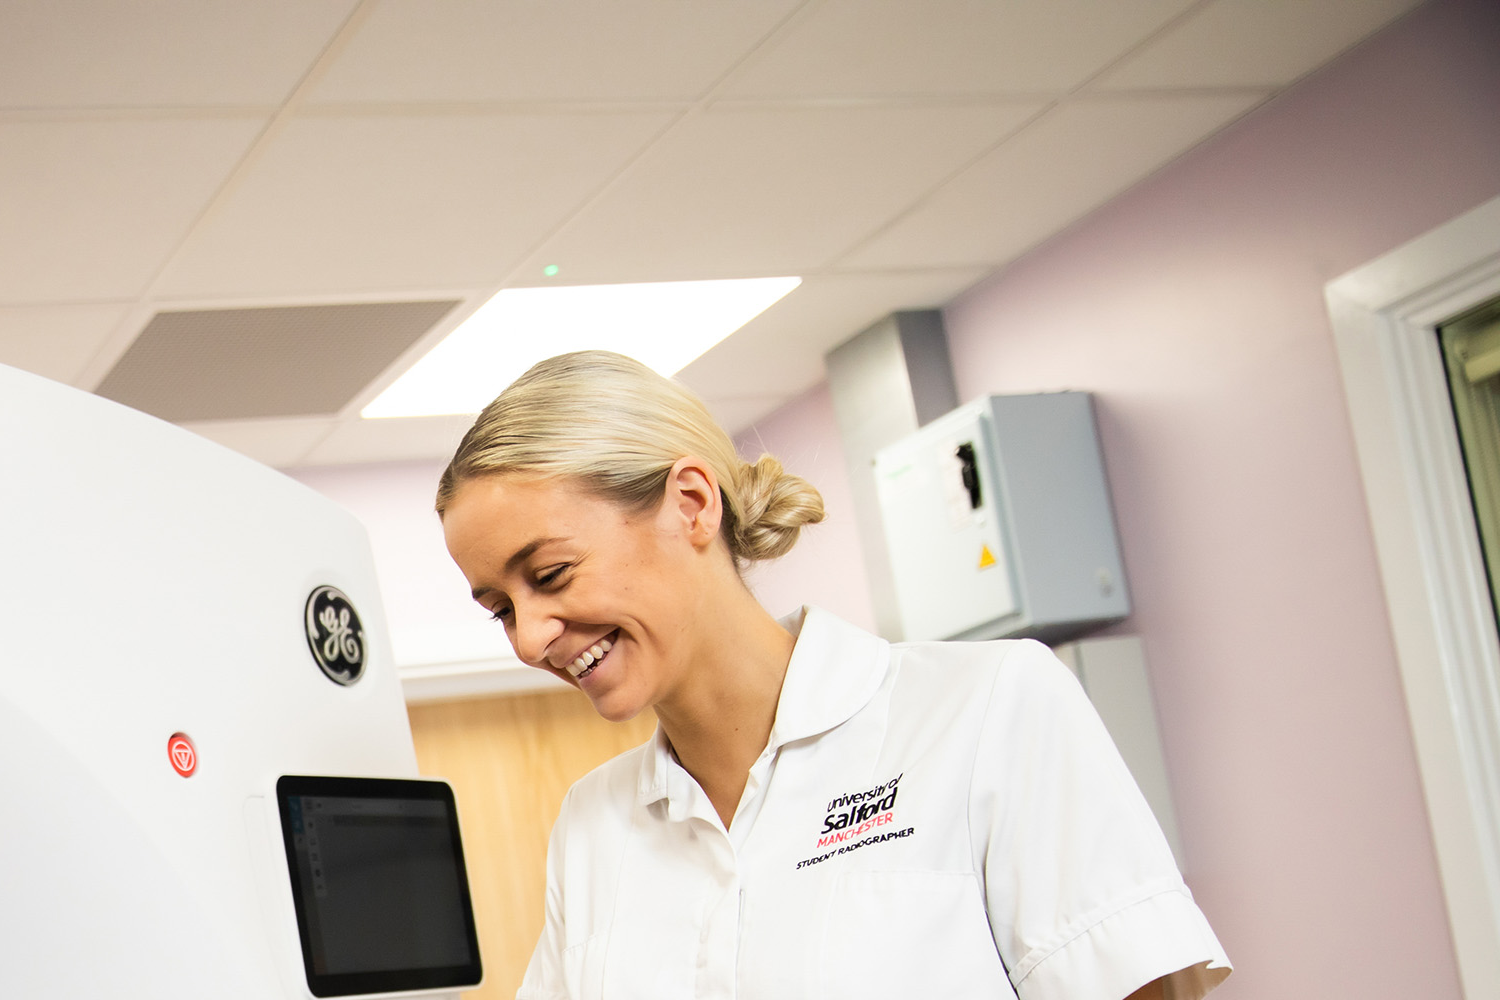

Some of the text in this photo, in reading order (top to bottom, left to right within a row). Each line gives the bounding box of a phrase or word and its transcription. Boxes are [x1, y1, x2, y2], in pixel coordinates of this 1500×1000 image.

[816, 812, 893, 848] MANCHESTER
[821, 787, 898, 834] Salford
[796, 827, 914, 869] STUDENT RADIOGRAPHER
